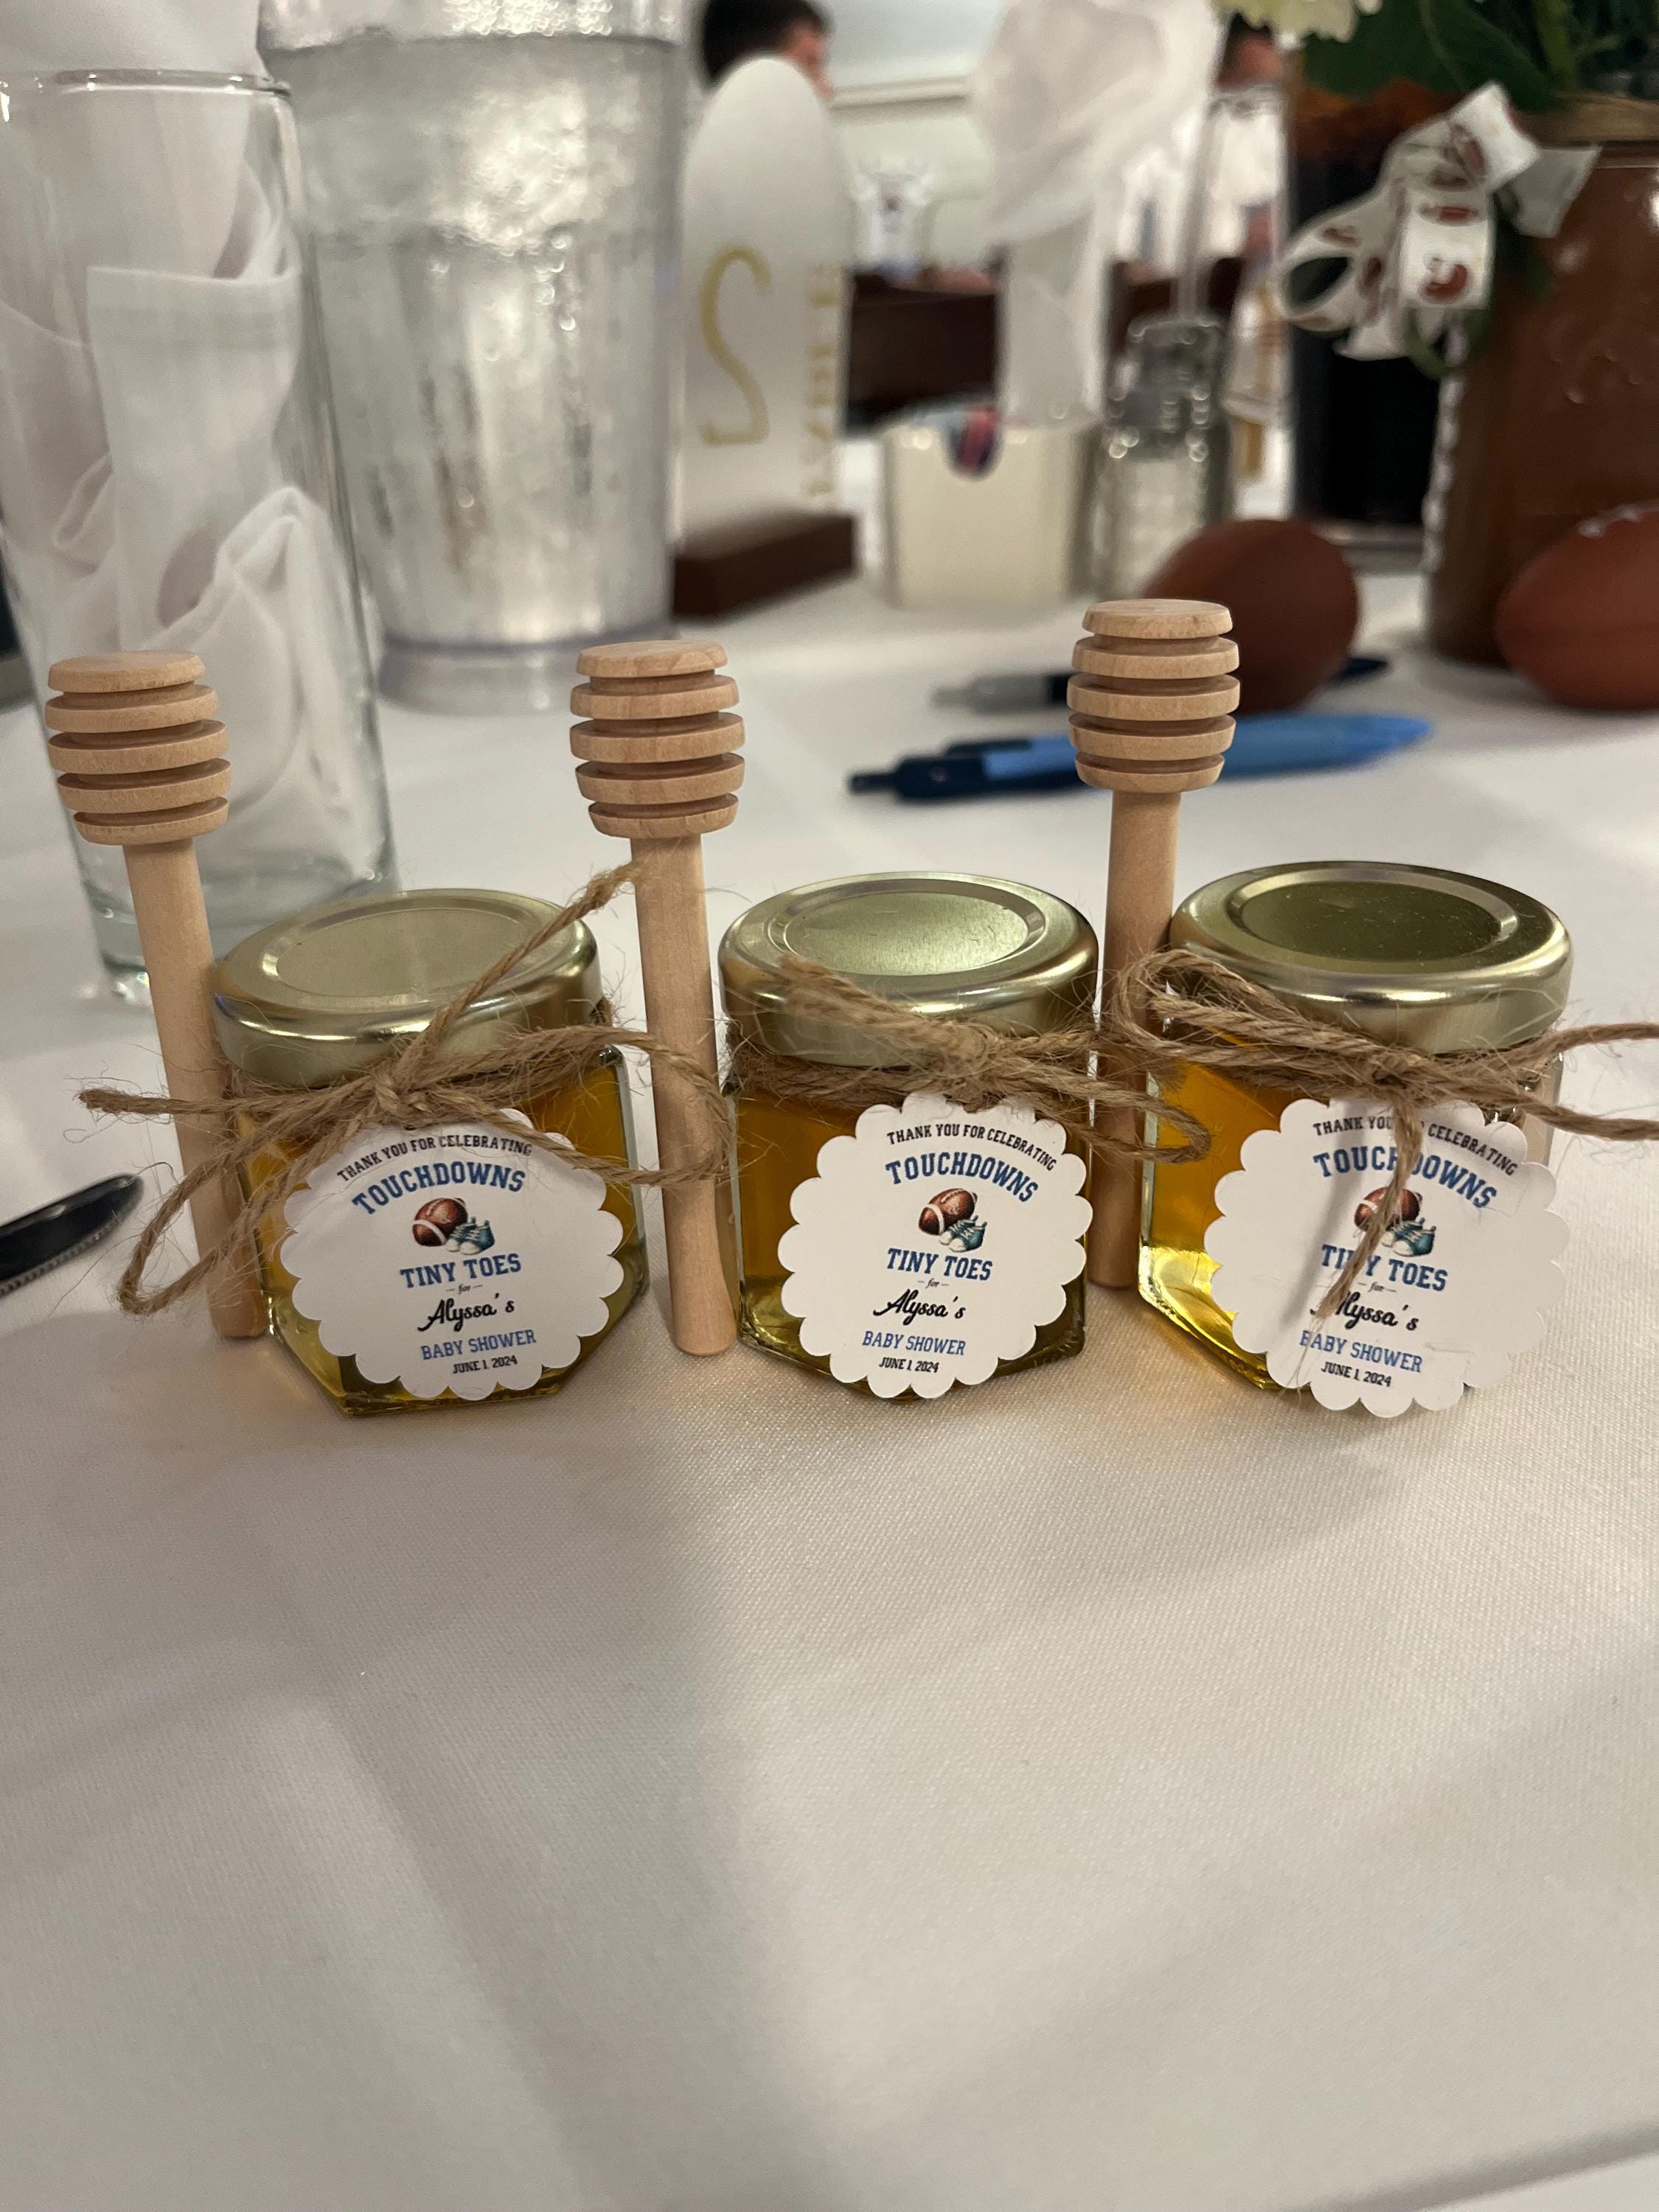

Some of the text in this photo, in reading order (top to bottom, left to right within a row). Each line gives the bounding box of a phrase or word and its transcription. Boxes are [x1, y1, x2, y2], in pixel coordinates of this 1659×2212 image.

[338, 1135, 532, 1181] THANK YOU FOR CELEBRATING
[887, 1123, 1057, 1172] THANK YOU FOR CELEBRATING
[1312, 1116, 1363, 1136] THANK
[1427, 1123, 1519, 1176] CELEBRATING
[352, 1161, 526, 1214] TOUCHDOWNS
[886, 1152, 1038, 1203] TOUCHDOWNS
[400, 1253, 521, 1288] TINY TOES
[887, 1248, 992, 1281] TINY TOES
[1322, 1244, 1448, 1292] TIY TOES
[457, 1284, 471, 1295] for
[924, 1278, 939, 1290] for
[1368, 1281, 1385, 1293] for
[417, 1293, 515, 1332] Alyssa's
[873, 1288, 966, 1326] Alyssa's
[420, 1329, 537, 1360] BABY SHOWER
[862, 1331, 966, 1356] BABY SHOWER
[1299, 1330, 1423, 1373] BABY SHOWER
[453, 1360, 481, 1374] JUNE
[491, 1355, 518, 1368] 2024
[879, 1357, 906, 1369] JUNE
[914, 1360, 939, 1373] 2024
[1321, 1361, 1352, 1378] JUNE
[1363, 1371, 1392, 1387] 2024
